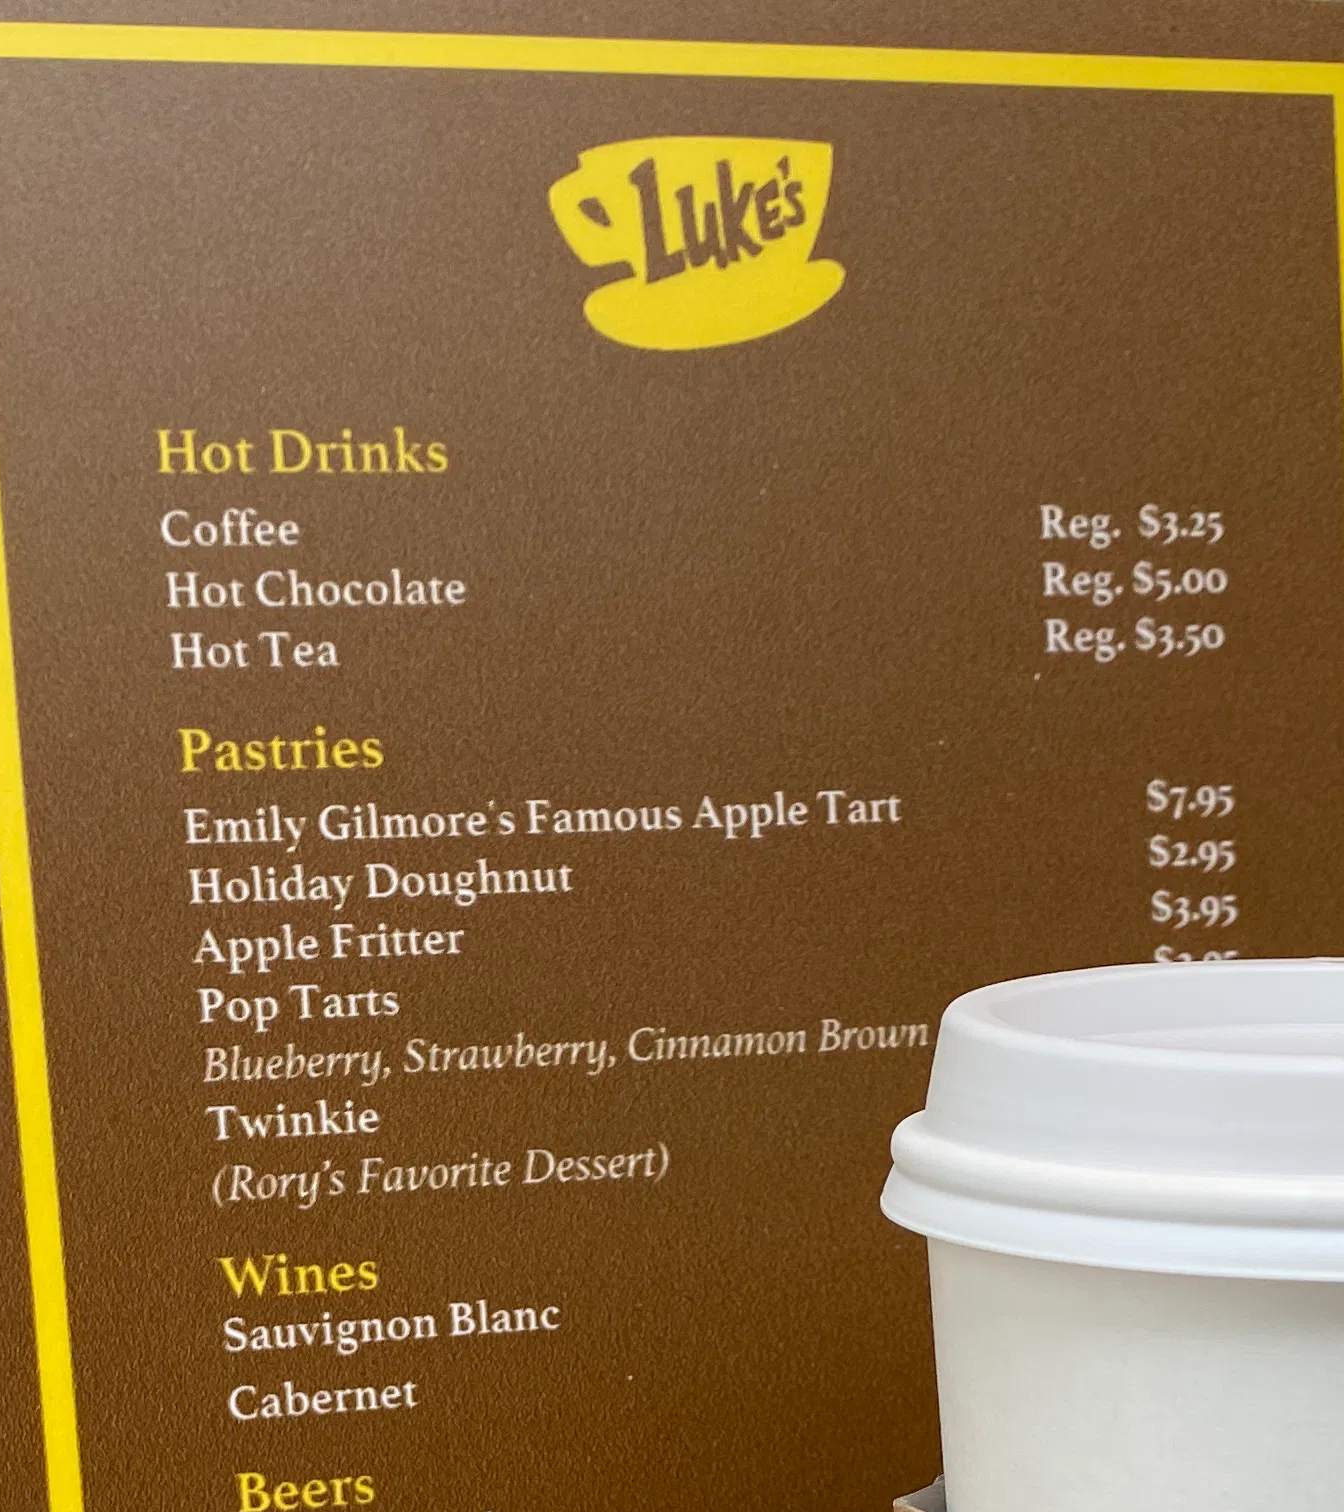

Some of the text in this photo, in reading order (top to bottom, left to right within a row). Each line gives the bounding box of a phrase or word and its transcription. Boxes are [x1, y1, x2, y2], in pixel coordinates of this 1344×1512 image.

[157, 426, 448, 474] Hot Drinks
[160, 507, 300, 547] Coffee
[1040, 503, 1224, 550] Reg. $3.25
[166, 567, 466, 608] Hot Chocolate
[1042, 560, 1228, 607] Reg. $5.00
[170, 631, 340, 669] Hot Tea
[1045, 616, 1225, 663] Reg. $3.50
[177, 725, 384, 773] Pastries
[183, 790, 902, 853] Emily Gilmore's Famous Apple Tart
[1146, 778, 1235, 820] $7.95
[1149, 834, 1236, 872] $2.95
[188, 858, 574, 911] Holiday Doughnut
[1151, 889, 1238, 929] $3.95
[193, 922, 465, 975] Apple Fritter
[196, 984, 400, 1033] Pop Tarts
[203, 1018, 929, 1087] Blueberry, Strawberry, Cinnamon Brown
[204, 1099, 379, 1141] Twinkie
[212, 1143, 669, 1210] (Rory's Favorite Dessert)
[218, 1253, 378, 1299] Wines
[223, 1299, 560, 1356] Sauvignon Blanc
[227, 1381, 418, 1421] Cabernet
